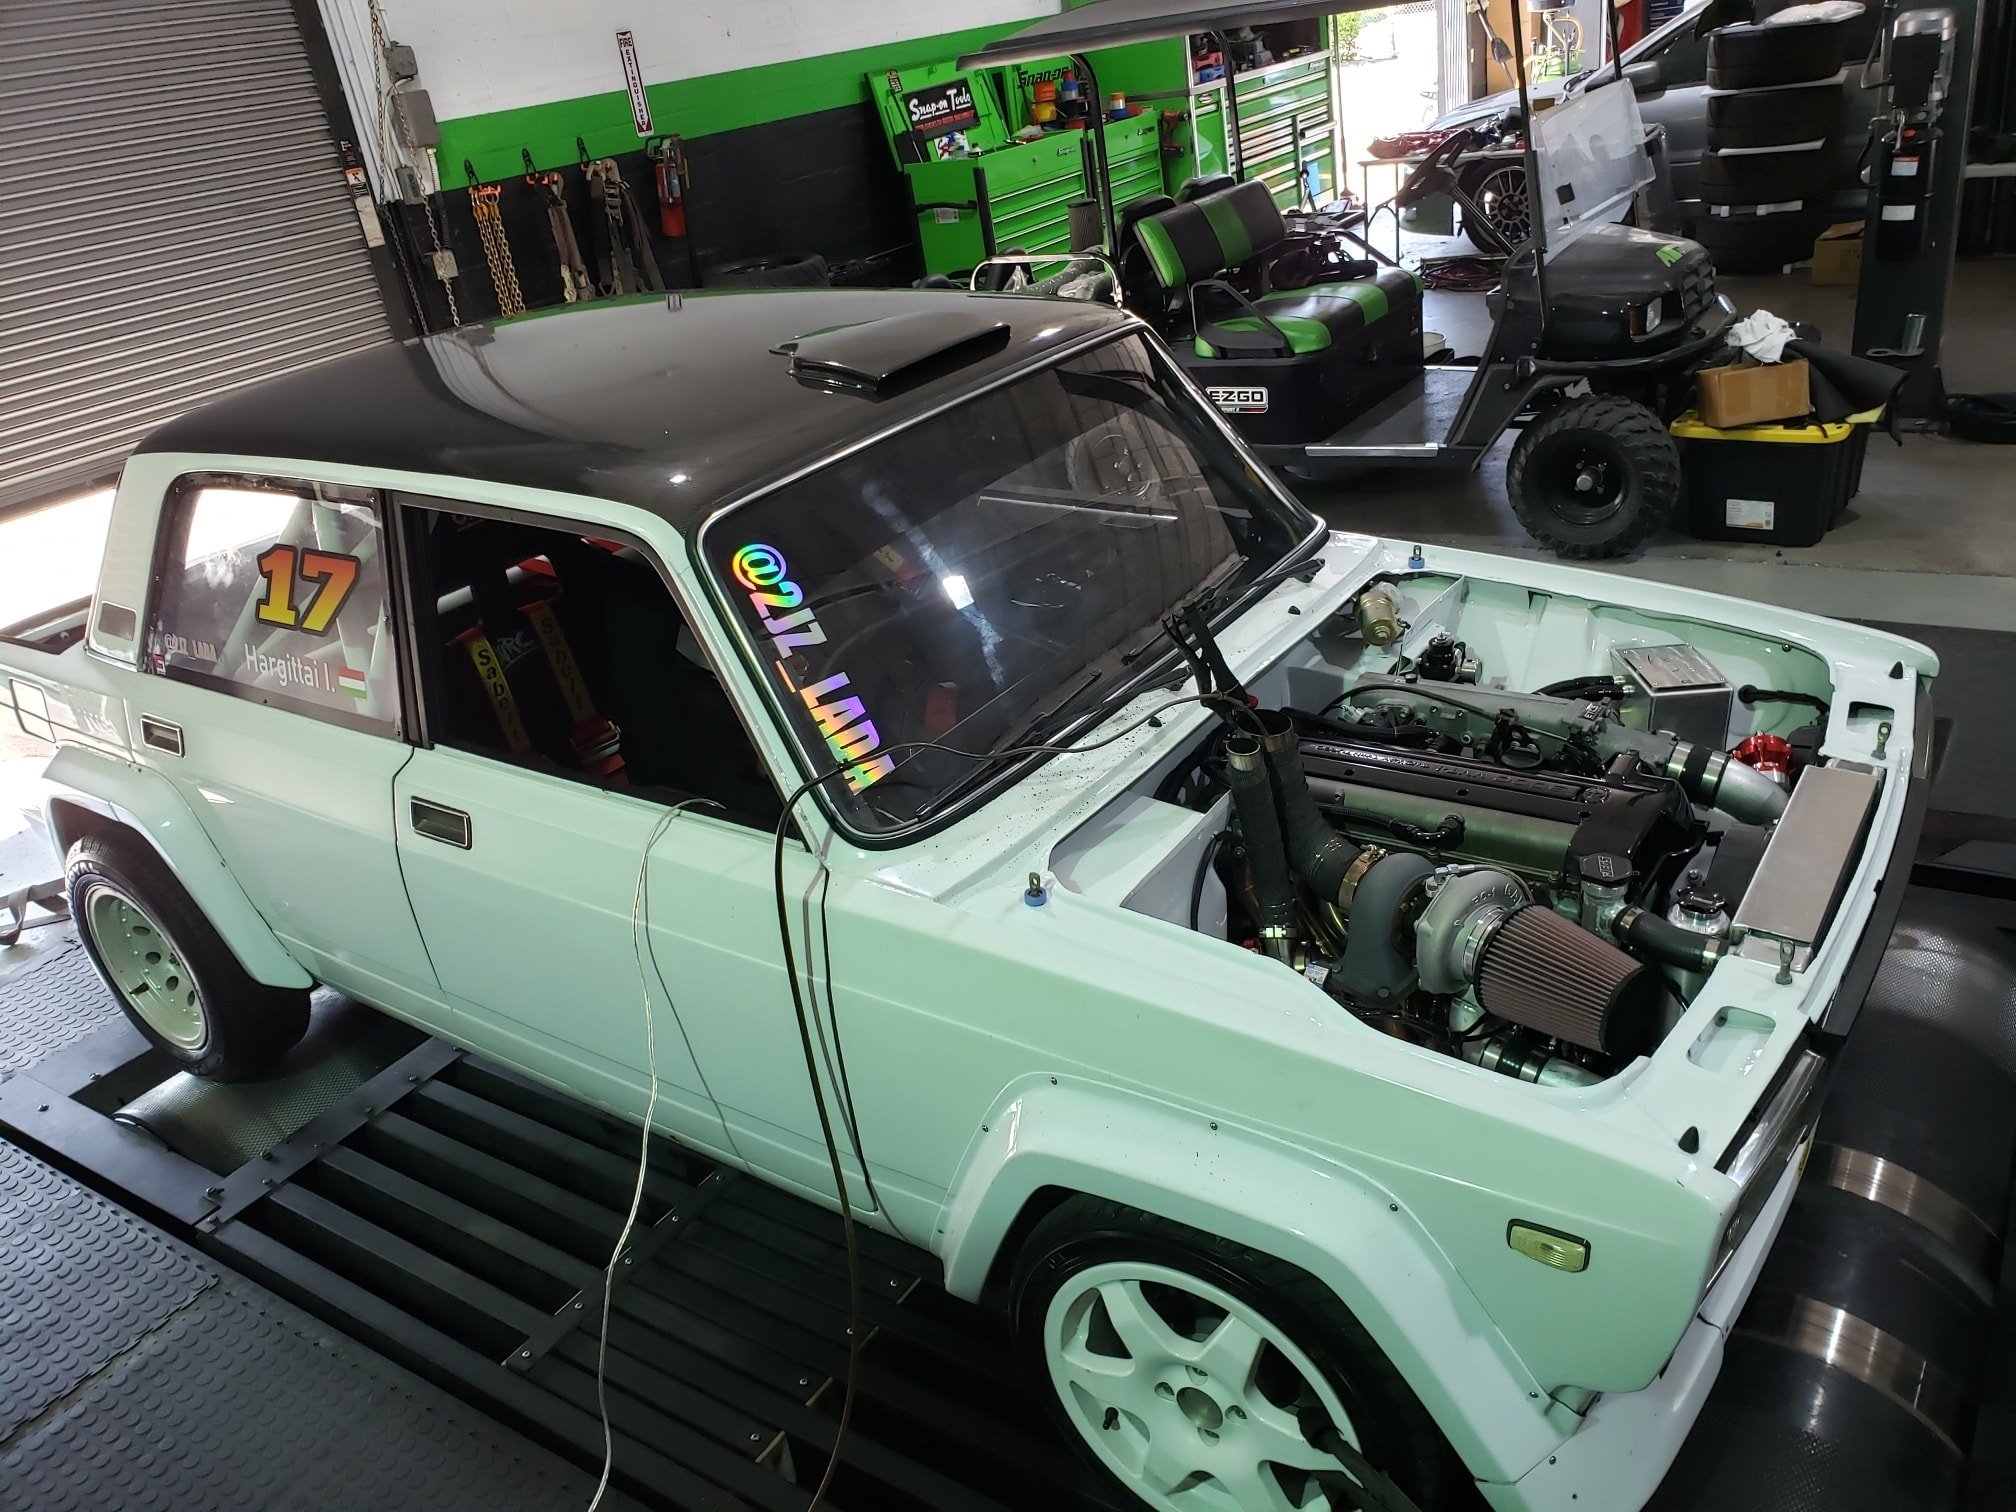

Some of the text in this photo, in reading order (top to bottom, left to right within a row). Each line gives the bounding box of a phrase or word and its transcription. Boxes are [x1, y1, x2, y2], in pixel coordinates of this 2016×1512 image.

[619, 37, 646, 126] FIRE EXTINGUISHER
[909, 98, 949, 122] Snap-on
[946, 87, 972, 111] Tools
[256, 544, 361, 637] 17
[244, 643, 320, 689] Hargittai
[732, 543, 896, 797] @2JZ_LADA
